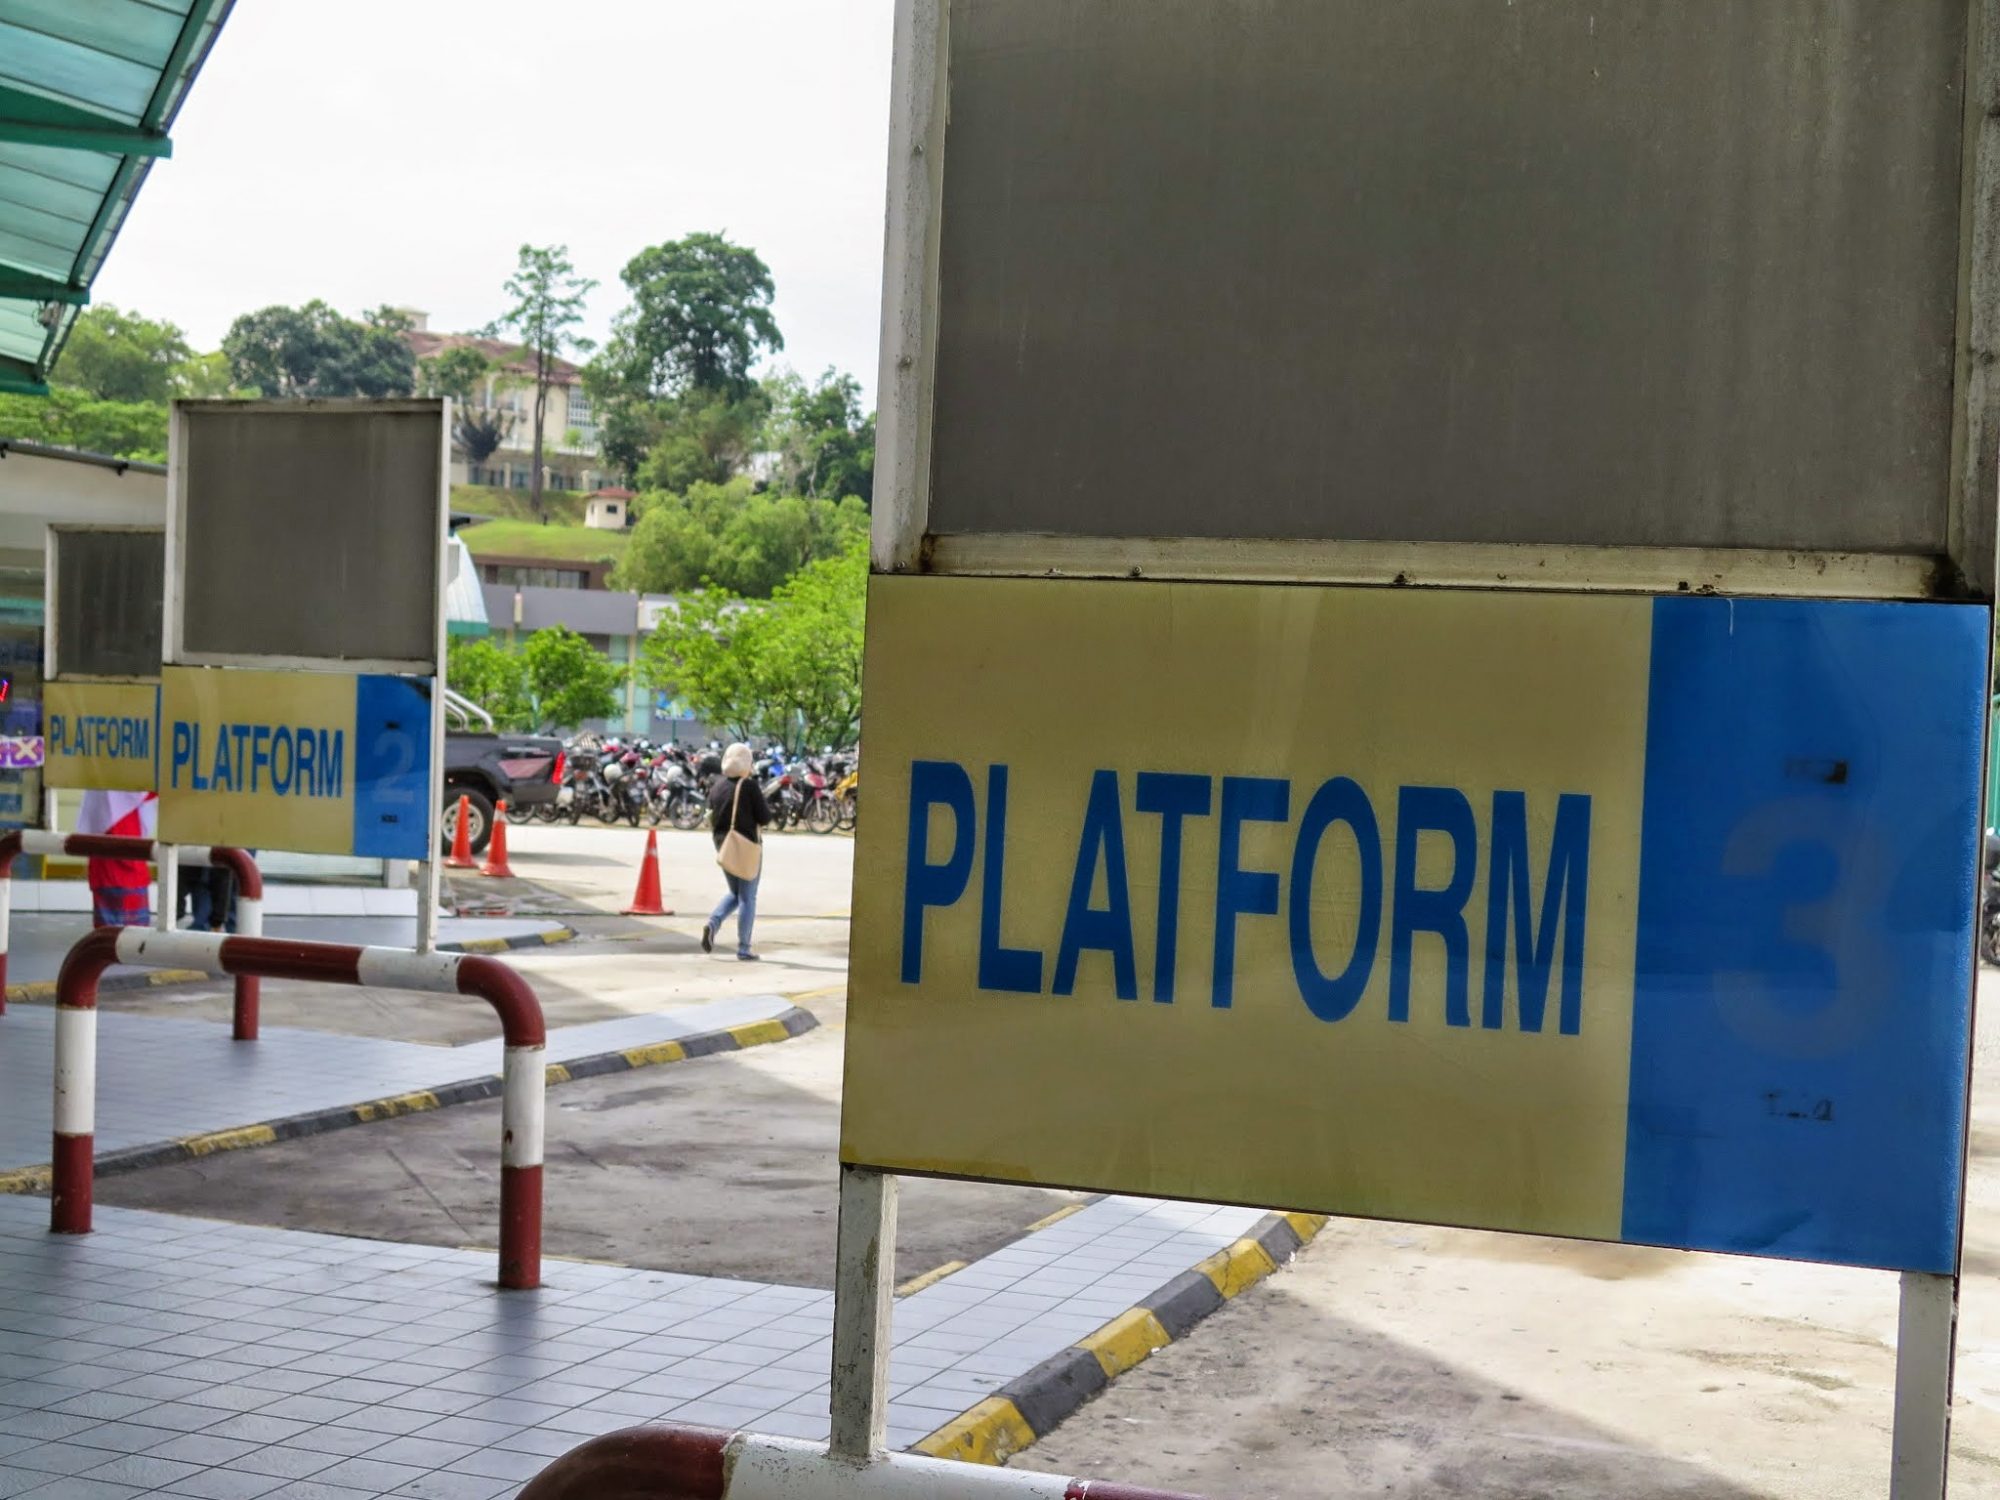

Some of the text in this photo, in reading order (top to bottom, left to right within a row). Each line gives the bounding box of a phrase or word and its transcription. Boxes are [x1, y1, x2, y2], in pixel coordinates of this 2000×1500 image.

[51, 715, 149, 758] PLATFORM
[172, 721, 415, 803] PLATFORM 2
[902, 760, 1890, 1060] PLATFORM 3
